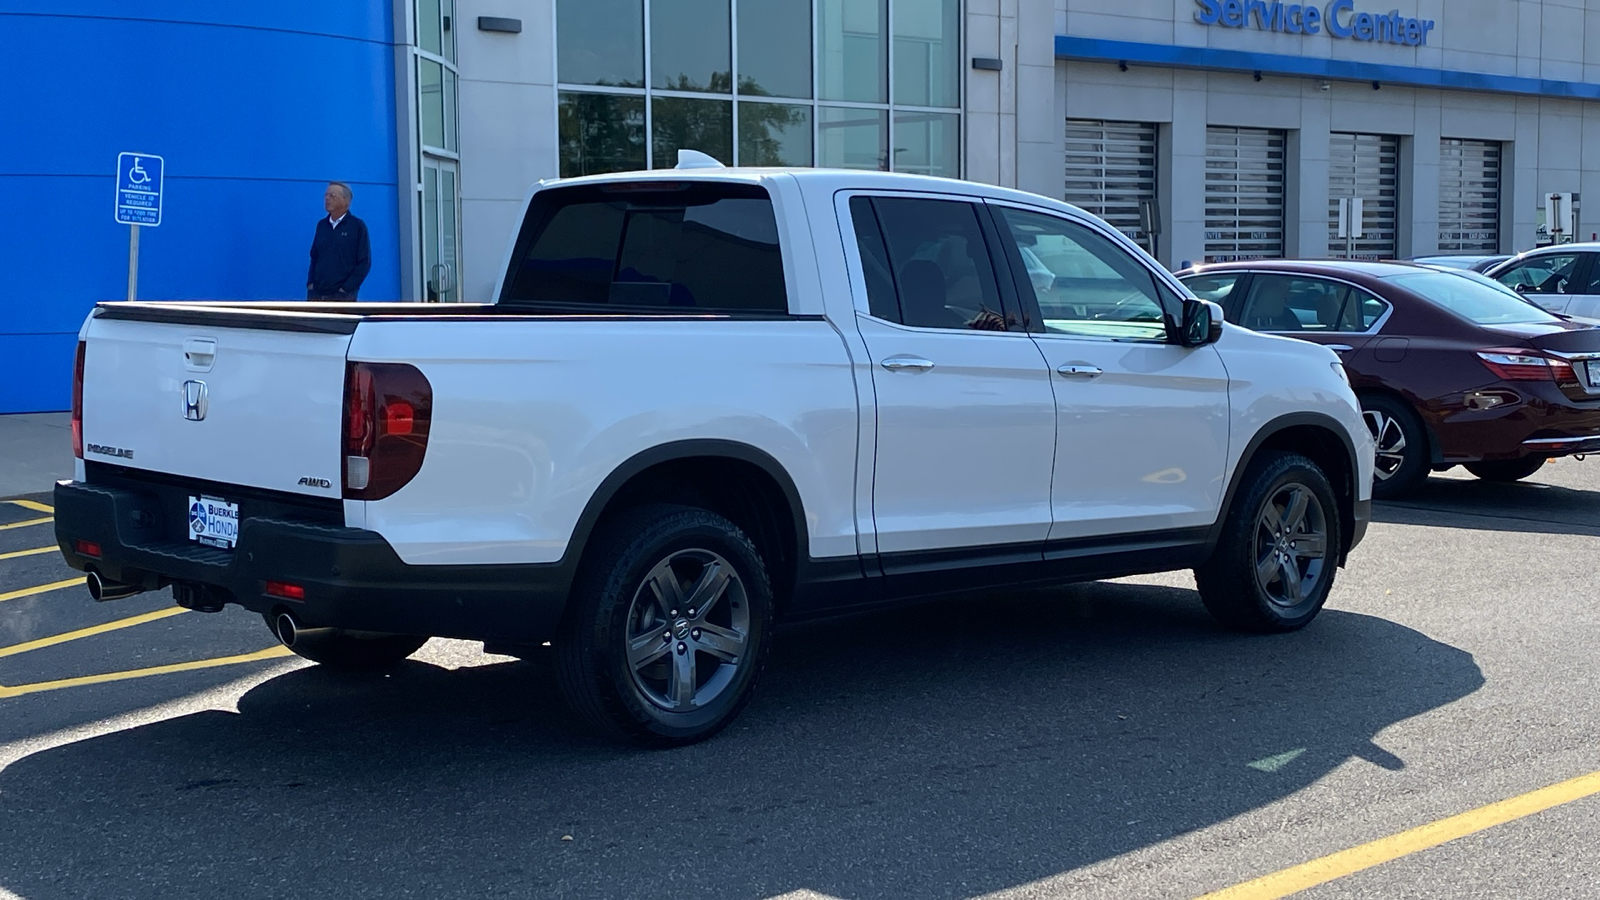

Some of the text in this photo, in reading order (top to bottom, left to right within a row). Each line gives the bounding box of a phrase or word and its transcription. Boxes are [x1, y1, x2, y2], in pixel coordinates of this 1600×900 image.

[1194, 0, 1434, 45] Service Center
[126, 199, 152, 207] REQUIRED
[1251, 232, 1267, 240] ENTER
[87, 443, 134, 460] RIDGELINE
[297, 476, 332, 488] AWD
[208, 504, 239, 520] BUERKLE
[208, 515, 238, 537] HONDA
